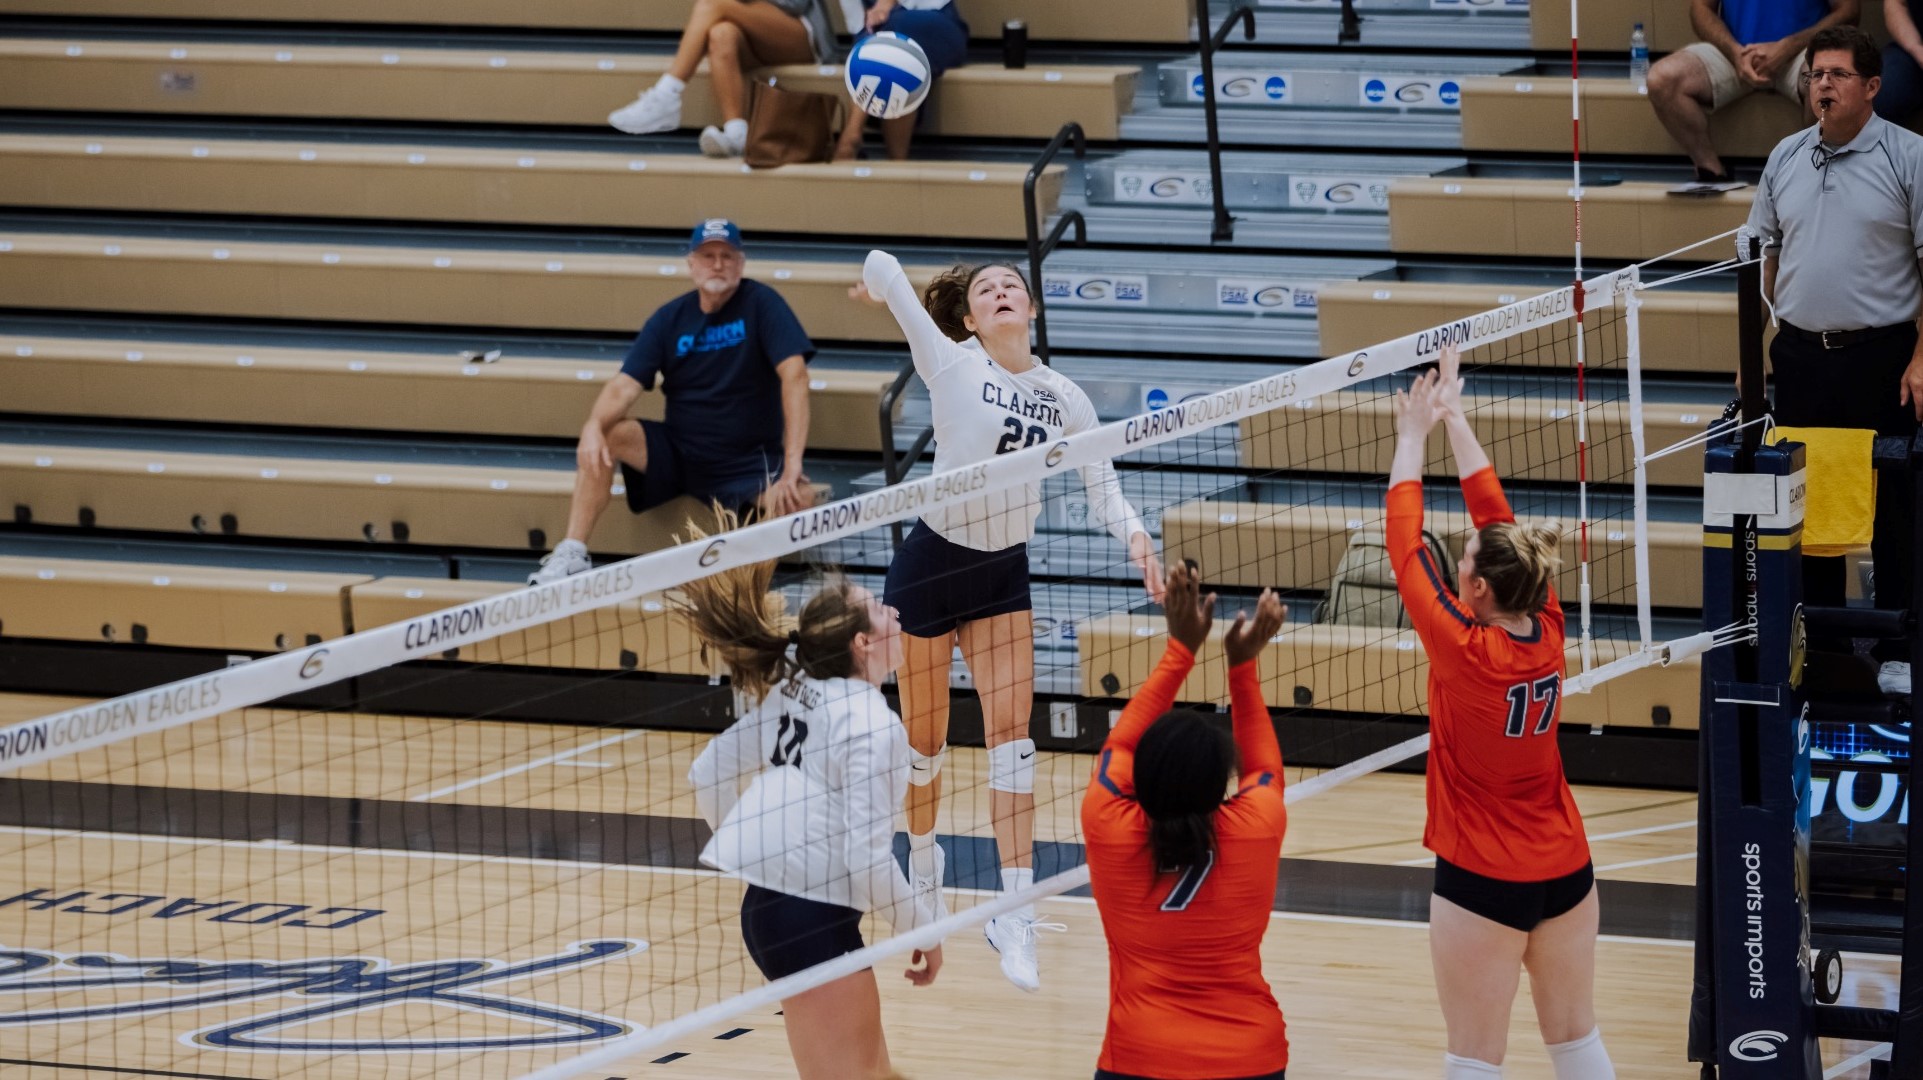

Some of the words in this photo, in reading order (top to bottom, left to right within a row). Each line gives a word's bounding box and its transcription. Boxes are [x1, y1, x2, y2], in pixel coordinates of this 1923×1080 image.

[1416, 319, 1471, 357] CLARION
[1472, 304, 1522, 340] GOLDEN
[1526, 289, 1570, 324] EAGLES
[996, 416, 1048, 455] 20
[1125, 406, 1186, 445] CLARION
[1187, 389, 1243, 426] GOLDEN
[1248, 373, 1297, 408] EAGLES
[790, 500, 862, 543] CLARION
[863, 482, 927, 522] GOLDEN
[933, 463, 988, 502] EAGLES
[1744, 530, 1757, 582] sports
[404, 604, 487, 650] CLARION
[488, 584, 564, 628] GOLDEN
[570, 563, 634, 606] EAGLES
[52, 701, 139, 747] GOLDEN
[146, 676, 222, 723] EAGLES
[1505, 670, 1561, 738] 17
[0, 887, 388, 930] COACH
[1159, 849, 1213, 912] 7
[1741, 842, 1764, 911] sports
[1744, 914, 1767, 999] imports
